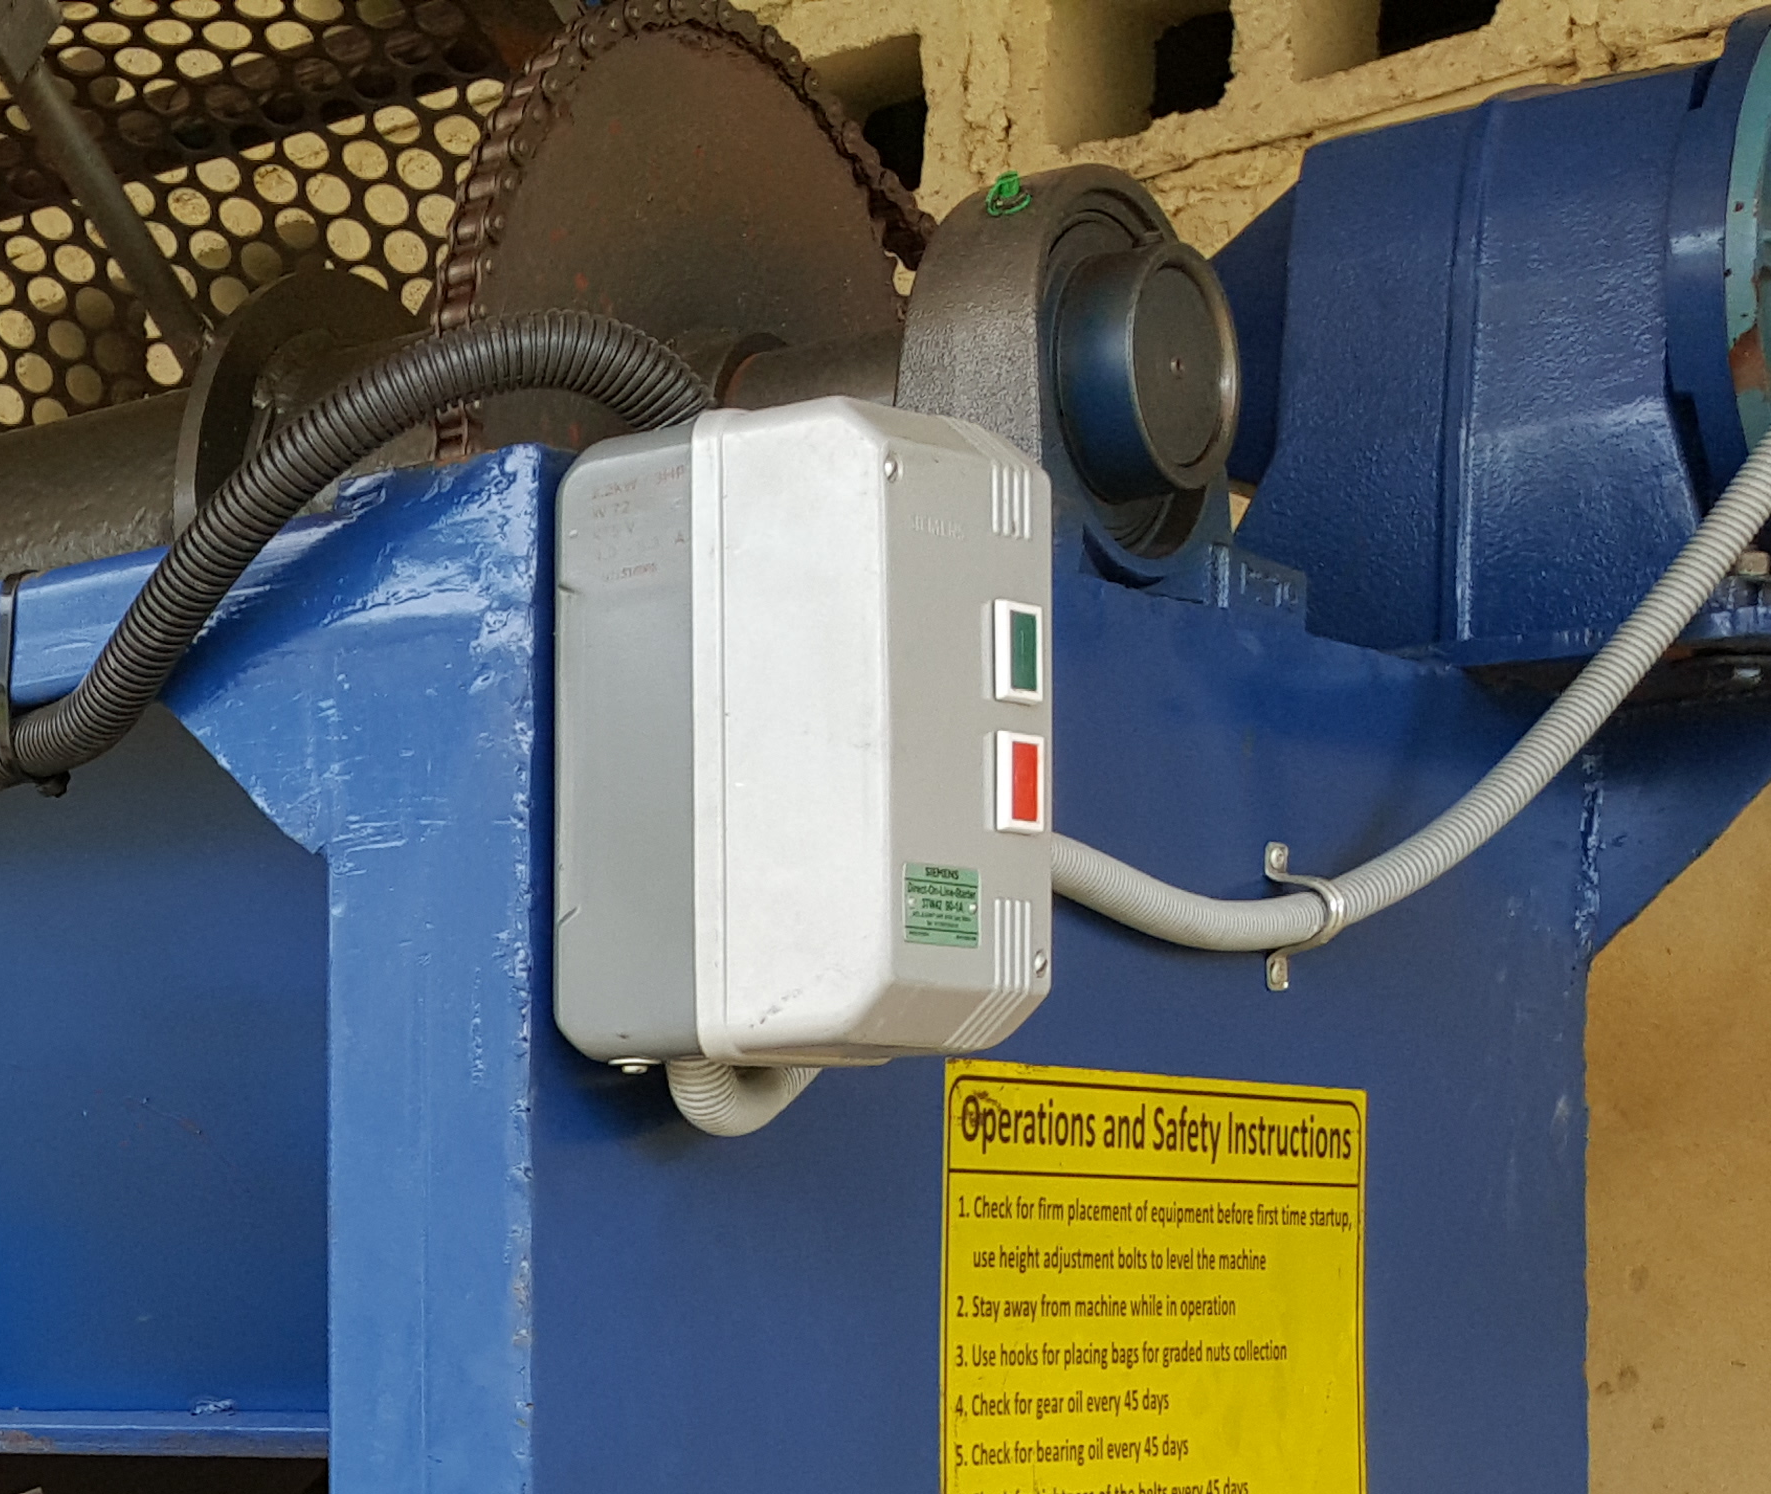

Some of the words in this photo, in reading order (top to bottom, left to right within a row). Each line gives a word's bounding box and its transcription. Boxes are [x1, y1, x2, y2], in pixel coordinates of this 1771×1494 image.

[925, 867, 959, 880] SIEMENS
[962, 1095, 1095, 1154] Operations
[1104, 1103, 1145, 1149] and
[1153, 1105, 1221, 1164] Safety
[1228, 1112, 1351, 1160] Instructions
[959, 1195, 970, 1218] 1.
[974, 1196, 1012, 1219] Check
[1017, 1196, 1034, 1219] for
[1038, 1197, 1064, 1220] firm
[1068, 1198, 1132, 1226] placement
[1136, 1200, 1148, 1222] of
[1151, 1201, 1214, 1228] equipment
[1217, 1202, 1254, 1225] before
[1257, 1204, 1278, 1225] first
[1282, 1204, 1307, 1226] time
[1309, 1207, 1352, 1232] startup,
[973, 1251, 995, 1267] use
[1000, 1245, 1040, 1273] height
[1044, 1246, 1114, 1274] adjustment
[1118, 1247, 1147, 1269] bolts
[1151, 1250, 1163, 1269] to
[1166, 1247, 1193, 1269] level
[1197, 1247, 1215, 1270] the
[1219, 1249, 1266, 1270] machine
[956, 1295, 968, 1317] 2.
[972, 1296, 1000, 1322] Stay
[1004, 1300, 1037, 1322] away
[1041, 1294, 1071, 1317] from
[1075, 1294, 1127, 1317] machine
[1131, 1294, 1162, 1316] while
[1167, 1295, 1177, 1316] in
[1180, 1295, 1236, 1322] operation
[956, 1345, 967, 1367] 3.
[972, 1344, 996, 1367] Use
[1000, 1343, 1038, 1366] hooks
[1042, 1342, 1060, 1365] for
[1064, 1342, 1108, 1370] placing
[1112, 1342, 1139, 1369] bags
[1143, 1341, 1159, 1363] for
[1162, 1340, 1202, 1368] graded
[1206, 1343, 1230, 1362] nuts
[1234, 1340, 1287, 1362] collection
[956, 1395, 967, 1417] 4.
[972, 1392, 1010, 1416] Check
[1014, 1392, 1033, 1414] for
[1036, 1396, 1064, 1420] gear
[1068, 1390, 1083, 1413] oil
[1087, 1395, 1121, 1417] every
[1124, 1390, 1139, 1411] 45
[1142, 1388, 1169, 1415] days
[956, 1445, 967, 1466] 5.
[972, 1441, 1010, 1466] Check
[1014, 1441, 1033, 1463] for
[1037, 1439, 1084, 1466] bearing
[1088, 1437, 1103, 1460] oil
[1107, 1441, 1141, 1463] every
[1144, 1436, 1158, 1457] 45
[1162, 1434, 1188, 1461] days
